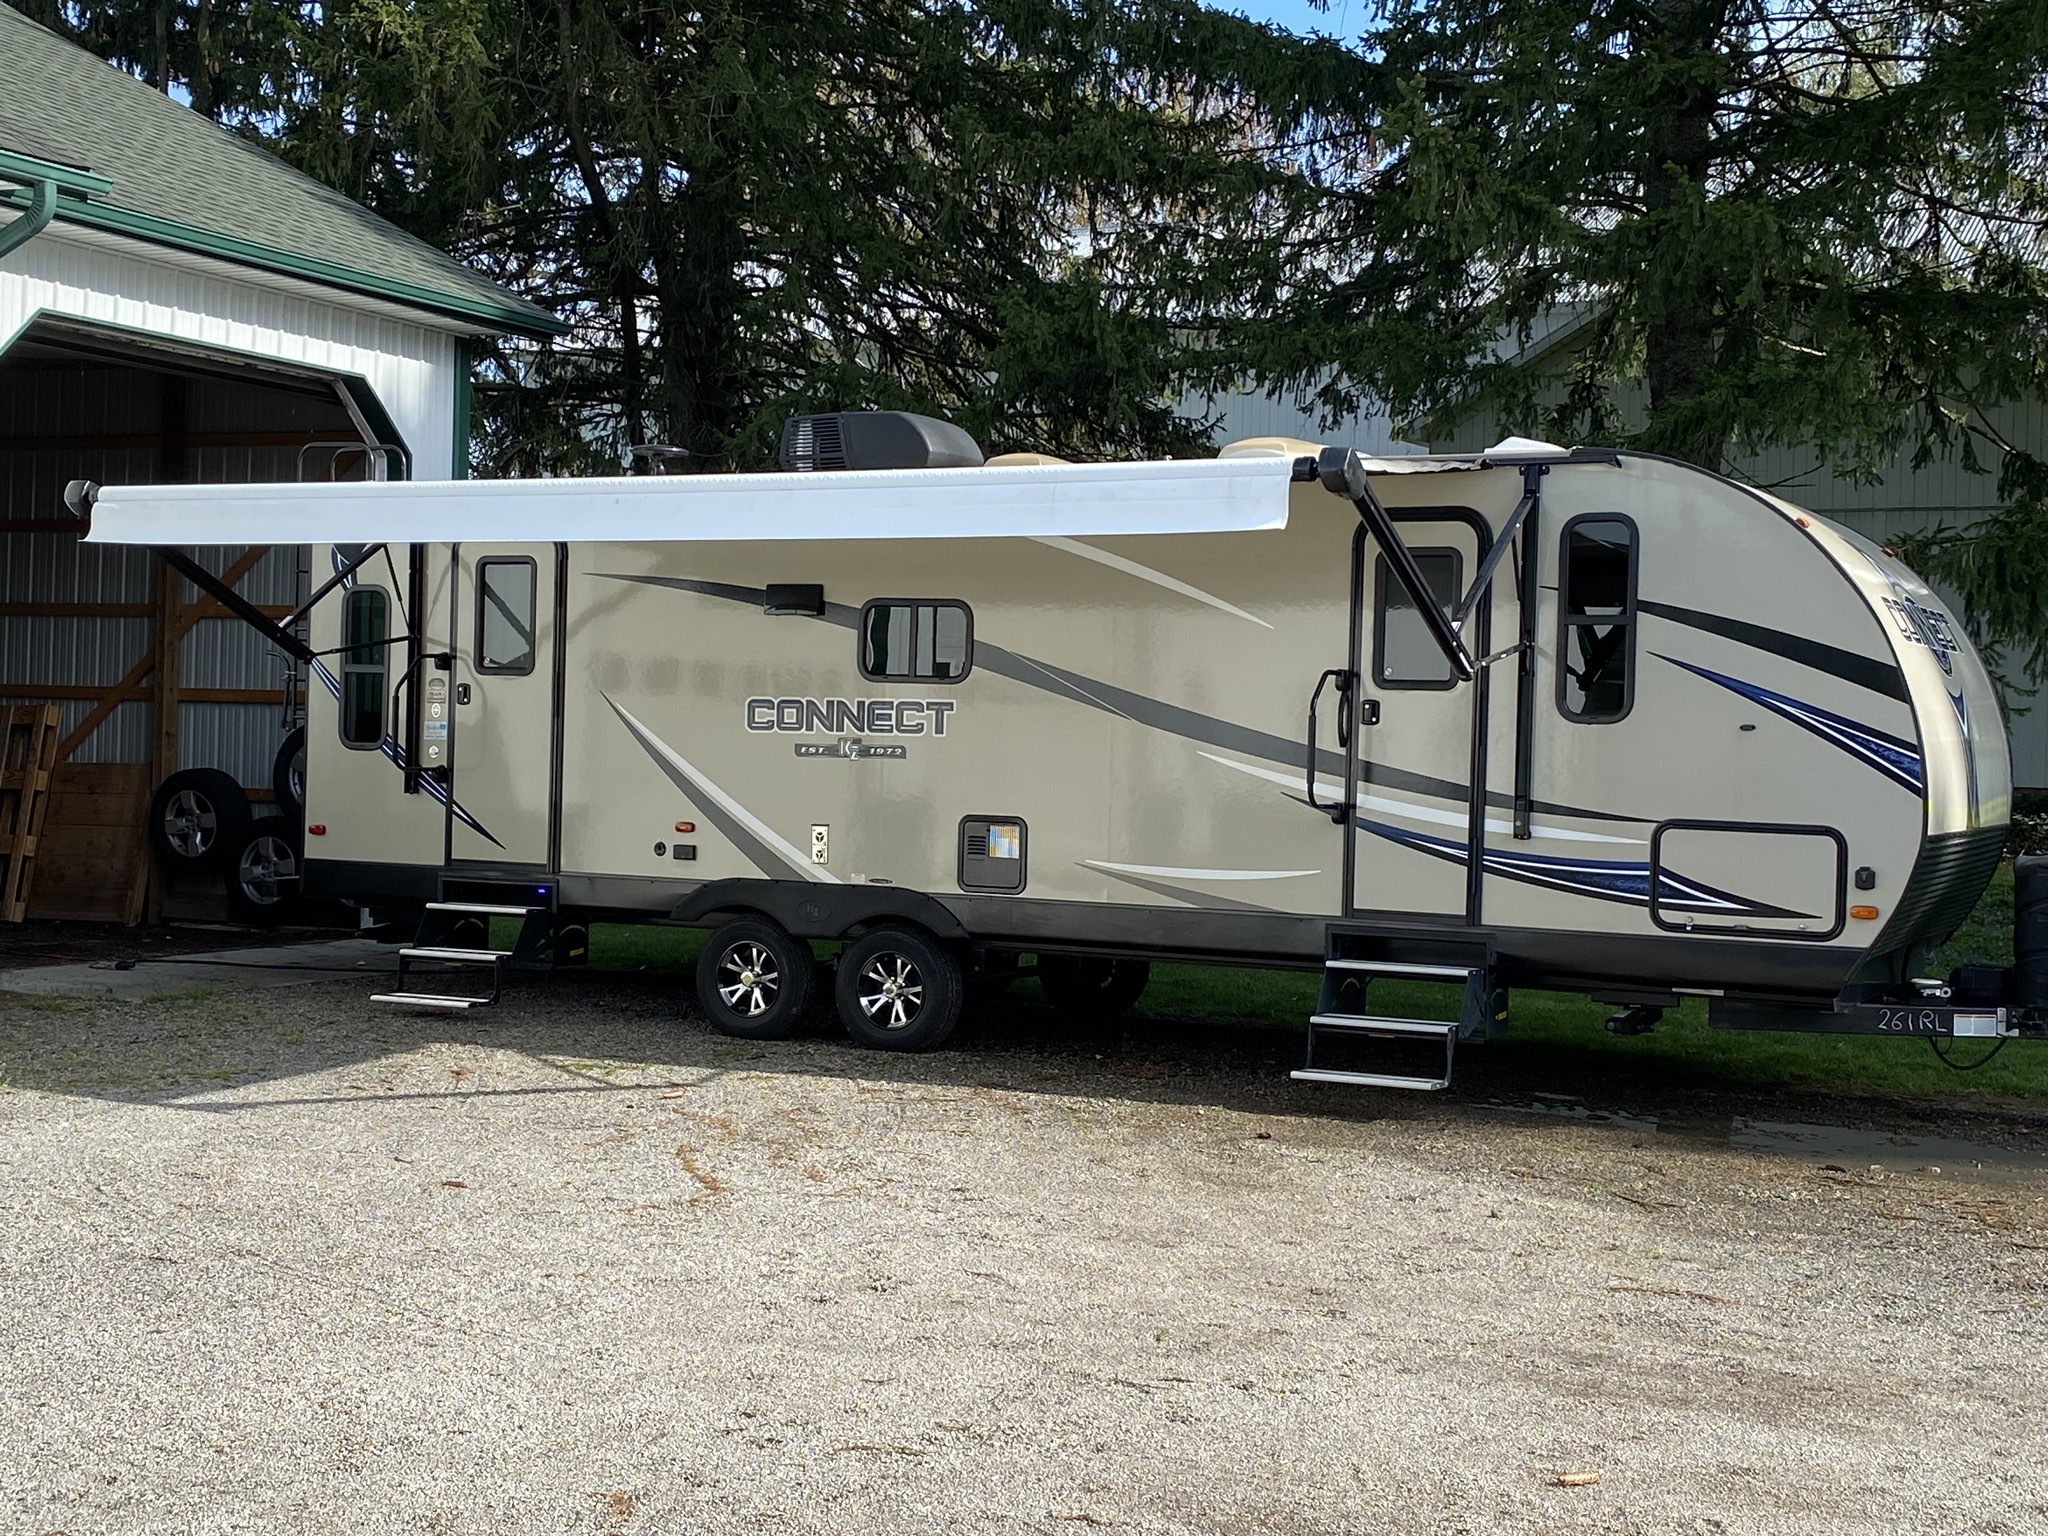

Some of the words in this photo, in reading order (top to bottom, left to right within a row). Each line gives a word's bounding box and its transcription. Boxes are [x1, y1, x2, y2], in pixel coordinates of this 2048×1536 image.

[746, 696, 956, 737] CONNECT
[800, 746, 829, 755] EST.
[869, 747, 902, 756] 1972
